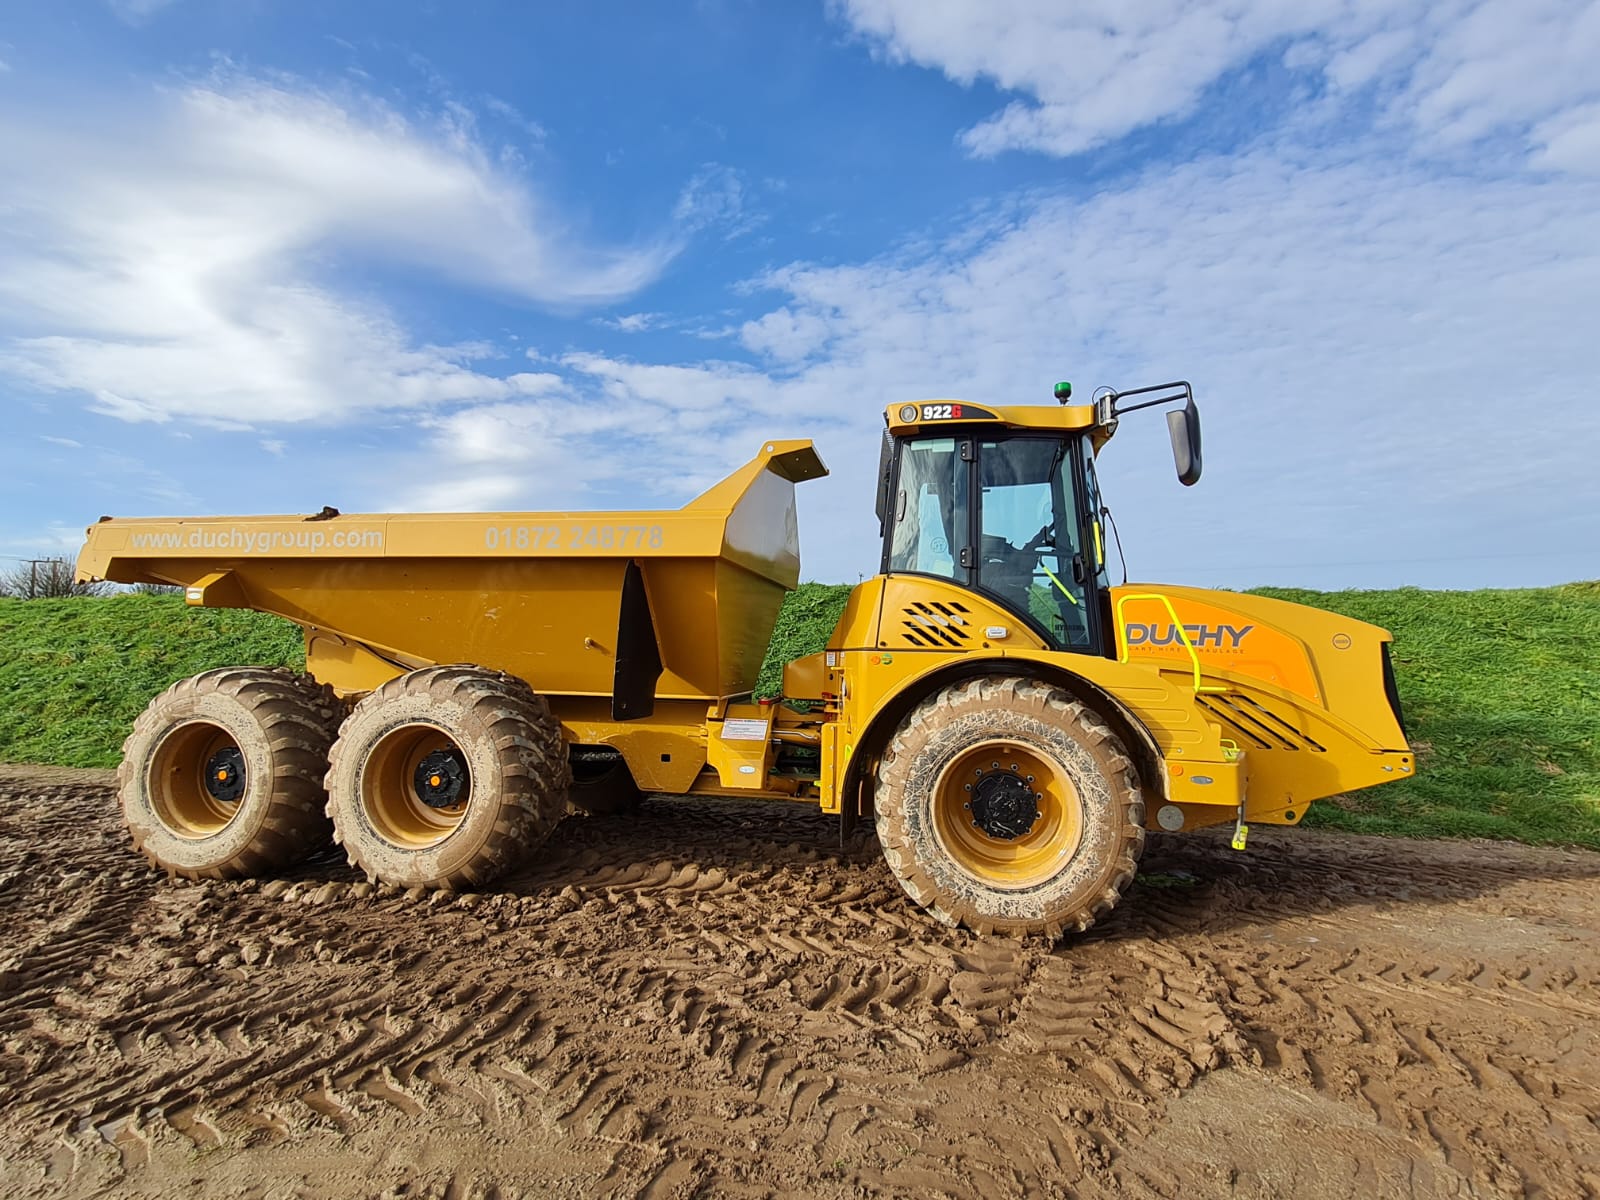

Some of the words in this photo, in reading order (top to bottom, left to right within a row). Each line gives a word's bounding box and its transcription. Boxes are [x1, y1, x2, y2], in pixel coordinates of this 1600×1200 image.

[923, 405, 962, 419] 922G
[131, 528, 383, 553] www.duchygroup.com
[485, 526, 561, 549] 01872
[569, 525, 663, 549] 248778
[1126, 623, 1254, 647] DUCHY
